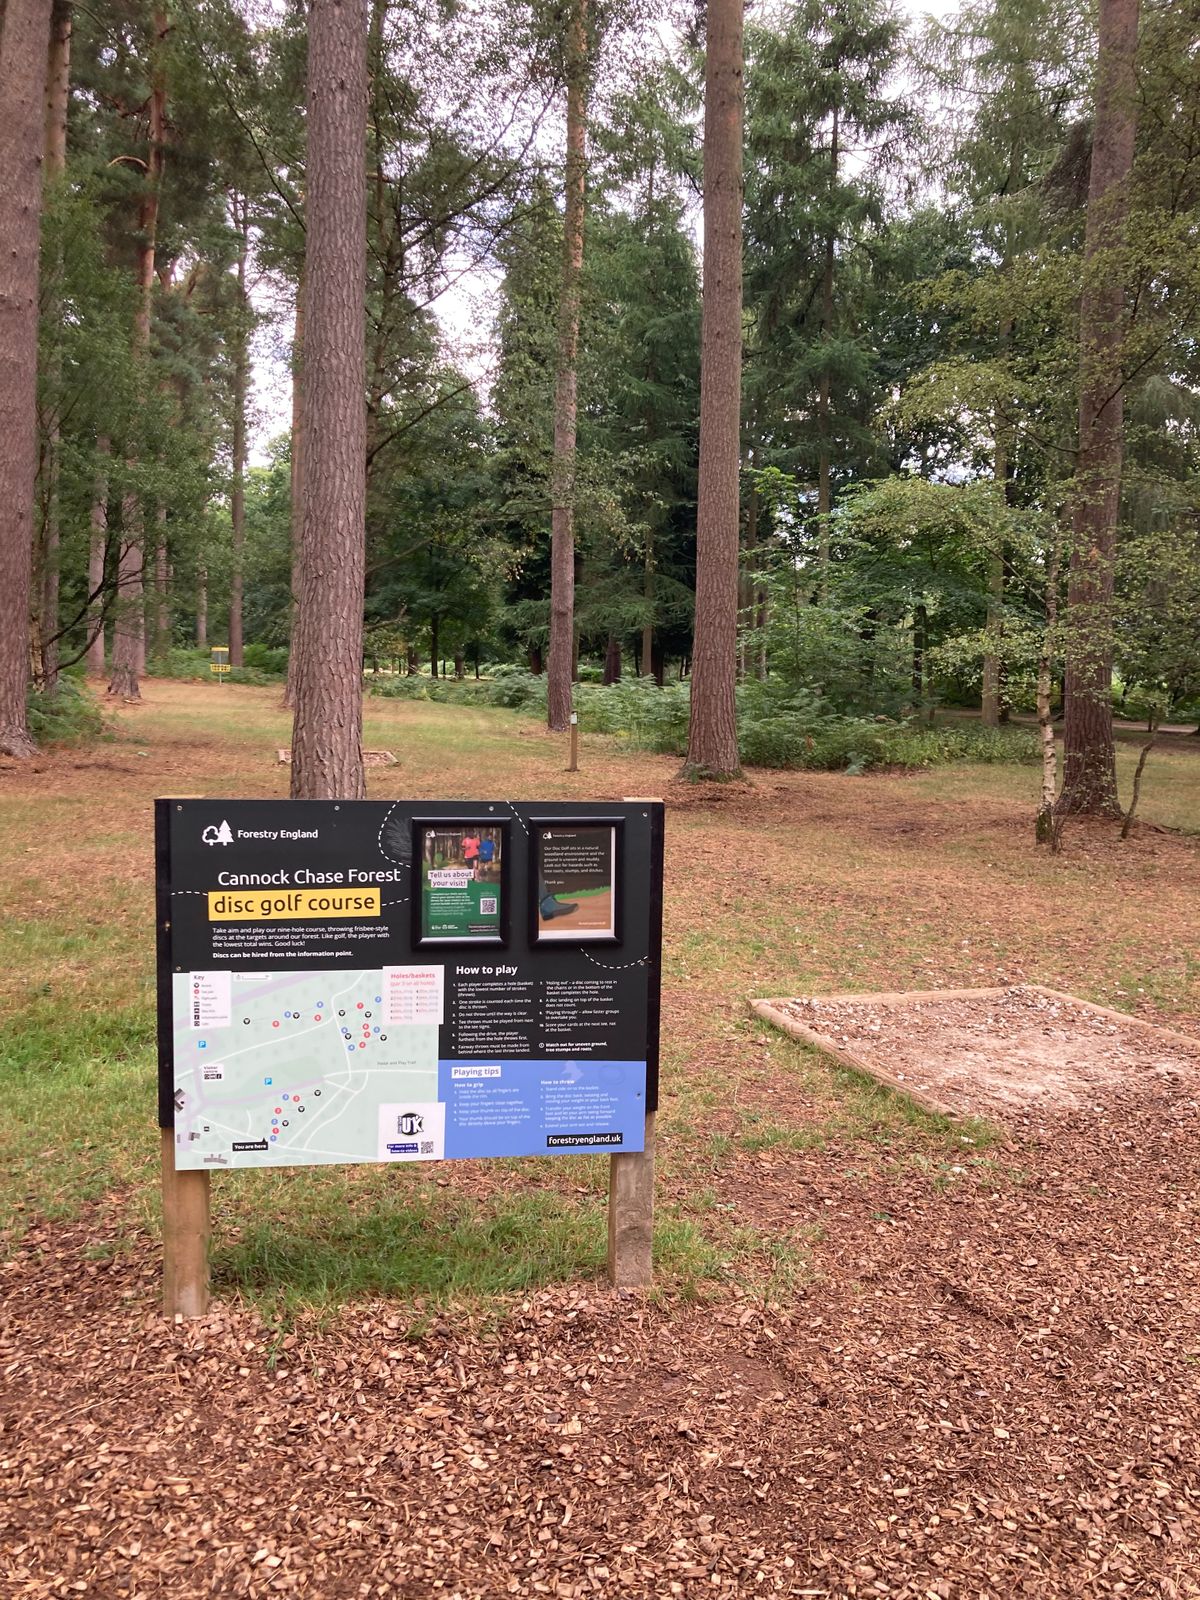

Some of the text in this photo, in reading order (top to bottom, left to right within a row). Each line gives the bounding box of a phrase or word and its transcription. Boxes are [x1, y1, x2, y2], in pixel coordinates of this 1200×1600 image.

[238, 830, 318, 840] Forestry England
[218, 869, 401, 886] Cannock Chase Forest
[214, 894, 375, 916] disc golf course
[456, 965, 518, 976] How to play
[454, 1068, 499, 1077] Playing tips
[548, 1135, 621, 1146] forestryengland.uk
